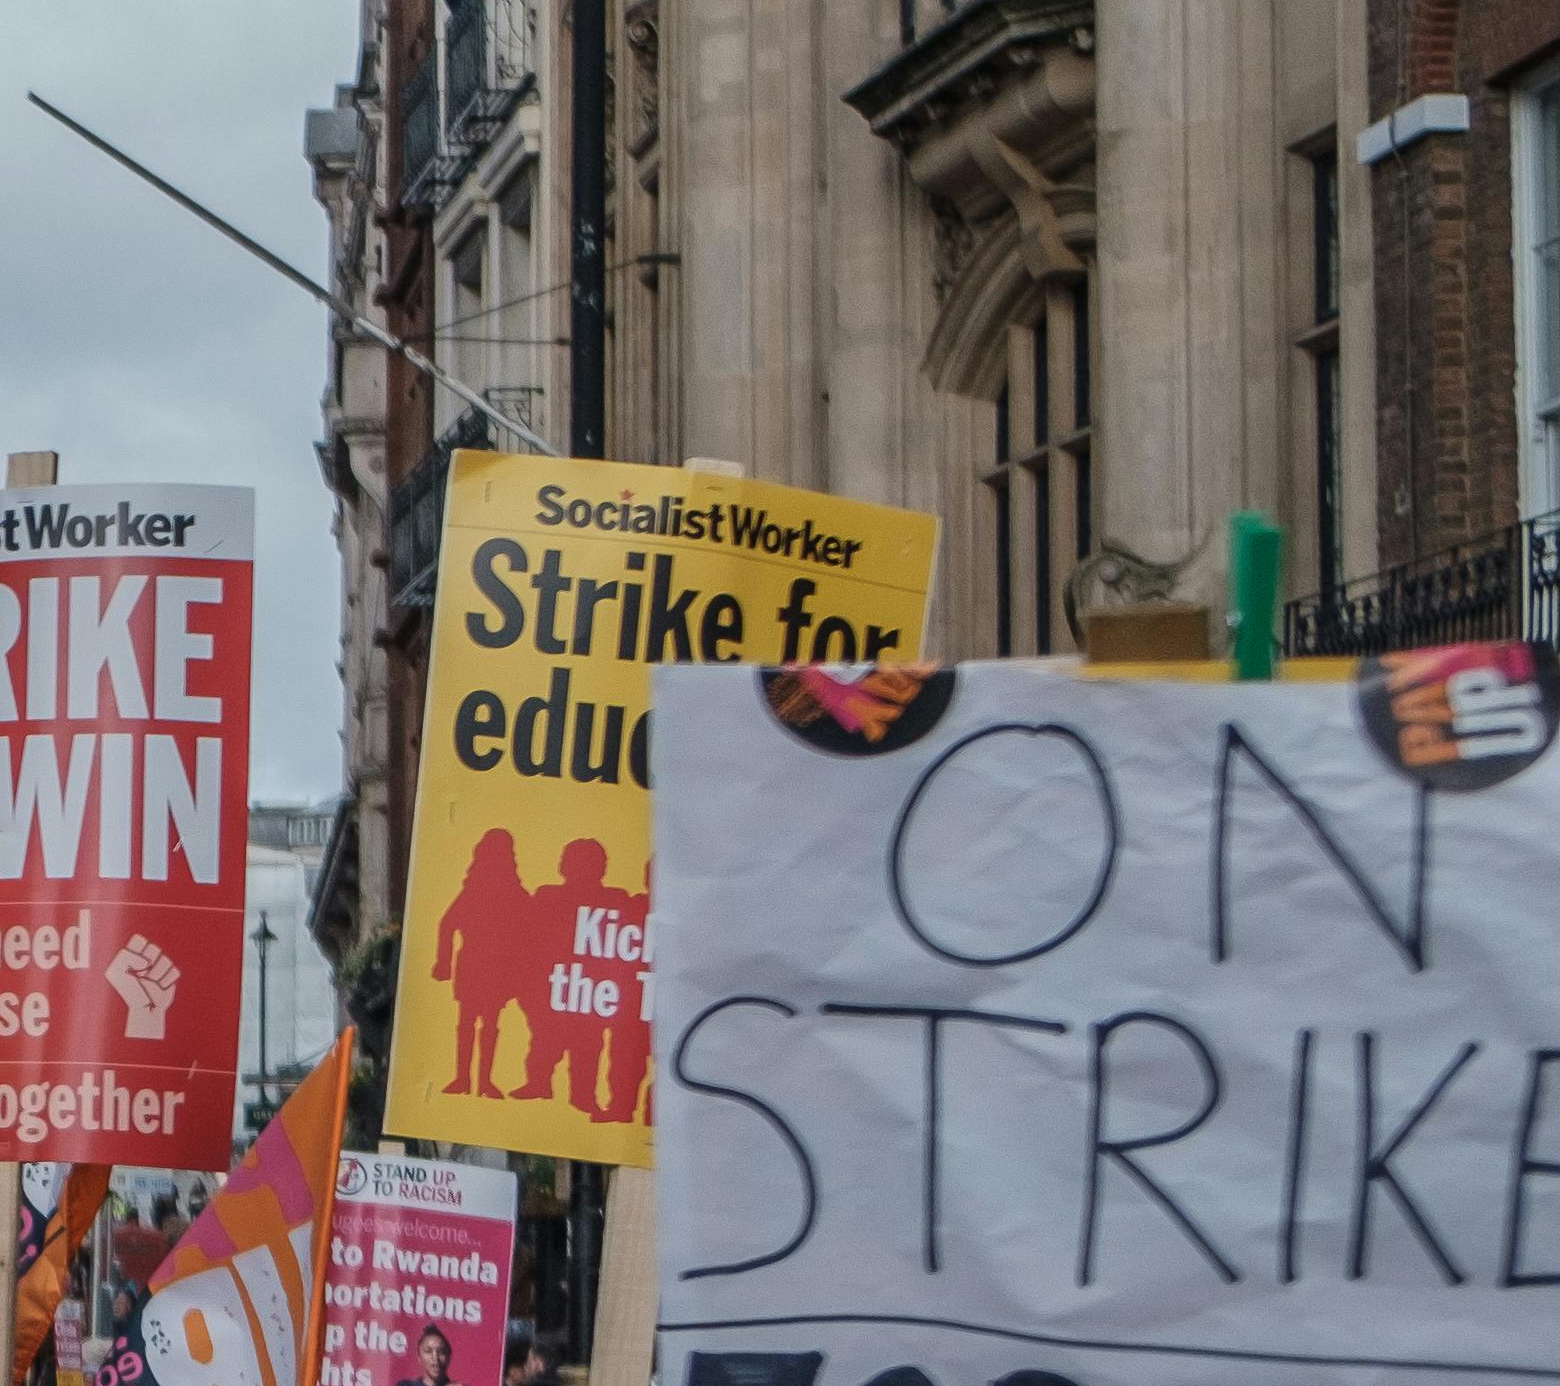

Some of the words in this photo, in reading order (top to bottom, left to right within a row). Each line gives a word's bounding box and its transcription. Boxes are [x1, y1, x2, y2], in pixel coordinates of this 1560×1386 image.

[466, 536, 743, 664] Strike
[777, 578, 899, 664] for
[888, 721, 1430, 971] ON
[549, 963, 620, 1019] the
[673, 996, 1560, 1287] STRIKE
[373, 1163, 426, 1182] STAND
[433, 1170, 456, 1186] UP
[373, 1180, 393, 1196] TO
[398, 1185, 462, 1205] RACISM
[331, 1237, 363, 1267] to
[373, 1239, 498, 1285] Rwanda
[355, 1322, 408, 1354] the
